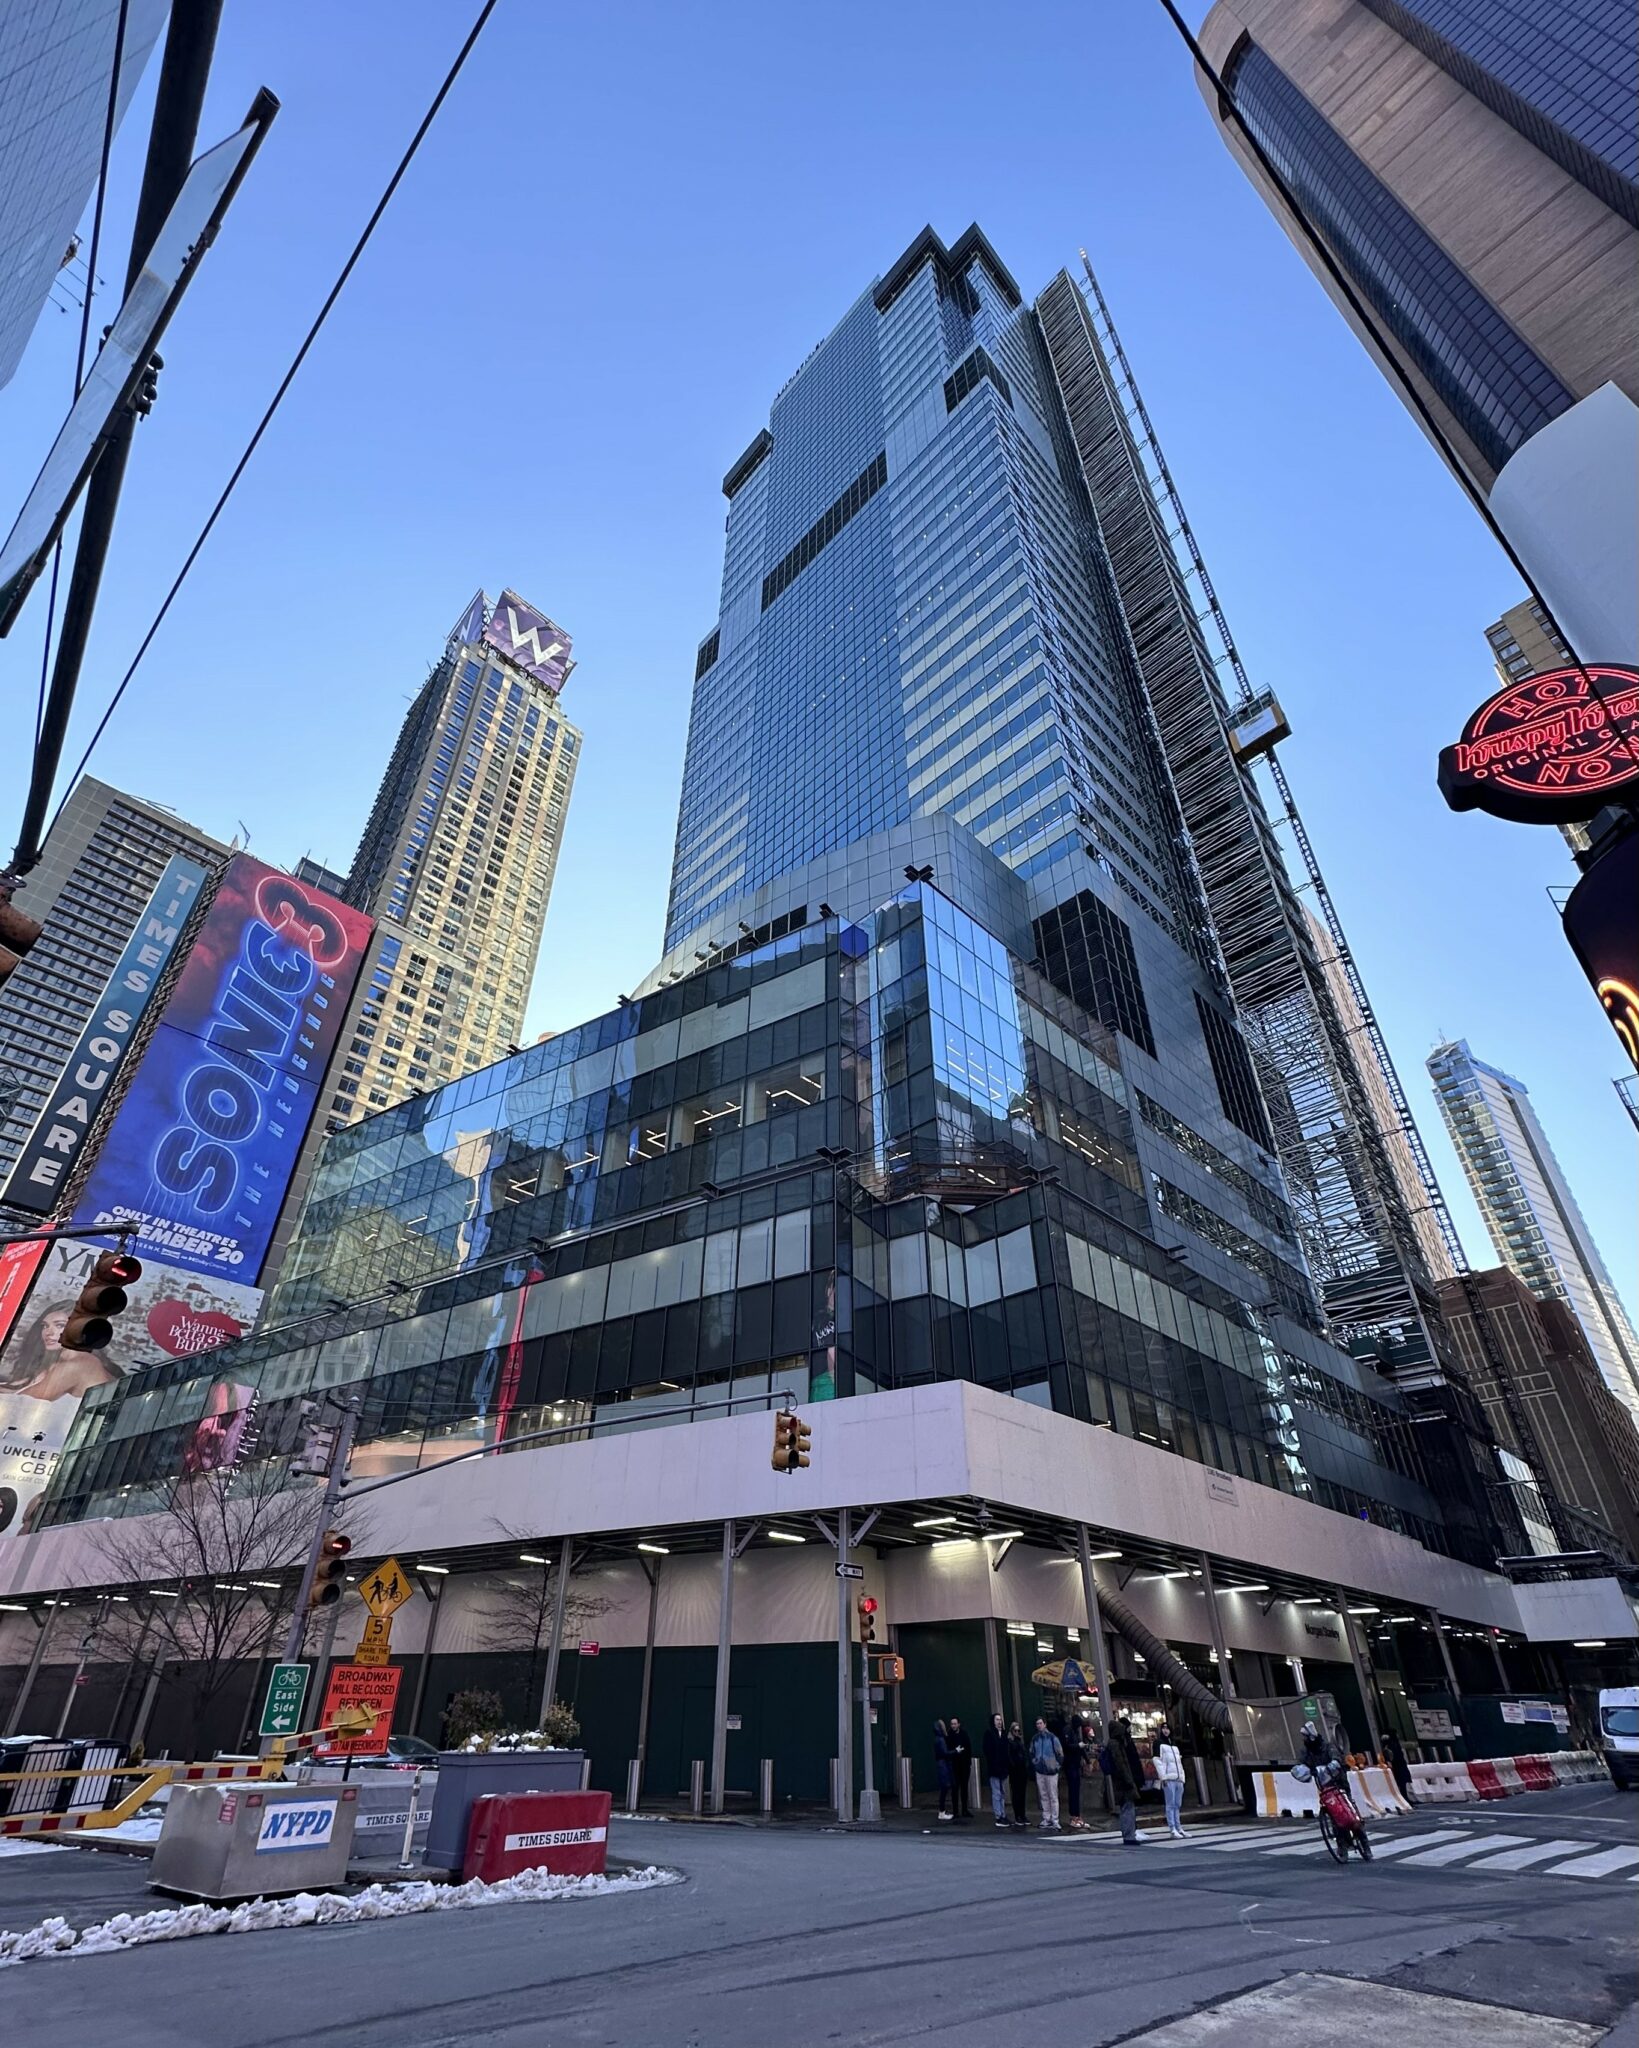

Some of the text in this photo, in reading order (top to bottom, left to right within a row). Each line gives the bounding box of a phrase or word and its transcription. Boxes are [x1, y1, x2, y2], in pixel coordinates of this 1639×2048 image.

[507, 606, 564, 666] W
[1500, 676, 1598, 718] HOT
[1455, 715, 1570, 772] Krispy
[1474, 738, 1588, 779] ORIGINAL
[1537, 735, 1639, 784] NOW
[29, 873, 197, 1187] TIMES SQUARE
[154, 875, 348, 1214] SONIC 3
[234, 973, 336, 1229] THE HEDGEHOG
[112, 1206, 239, 1249] ONLY IN THEATRES
[214, 1248, 244, 1265] 20
[169, 1325, 205, 1343] Betta
[181, 1316, 225, 1337] Wanna
[3, 1445, 47, 1460] UNCLE
[373, 1619, 383, 1634] 5
[338, 1671, 394, 1682] BROADWAY
[275, 1690, 297, 1700] East
[332, 1684, 395, 1695] WILL BE CLOSED
[273, 1702, 294, 1712] Side
[262, 1809, 333, 1839] NYPD
[366, 1814, 394, 1826] TIMES
[518, 1830, 592, 1847] TIMES SQUARE
